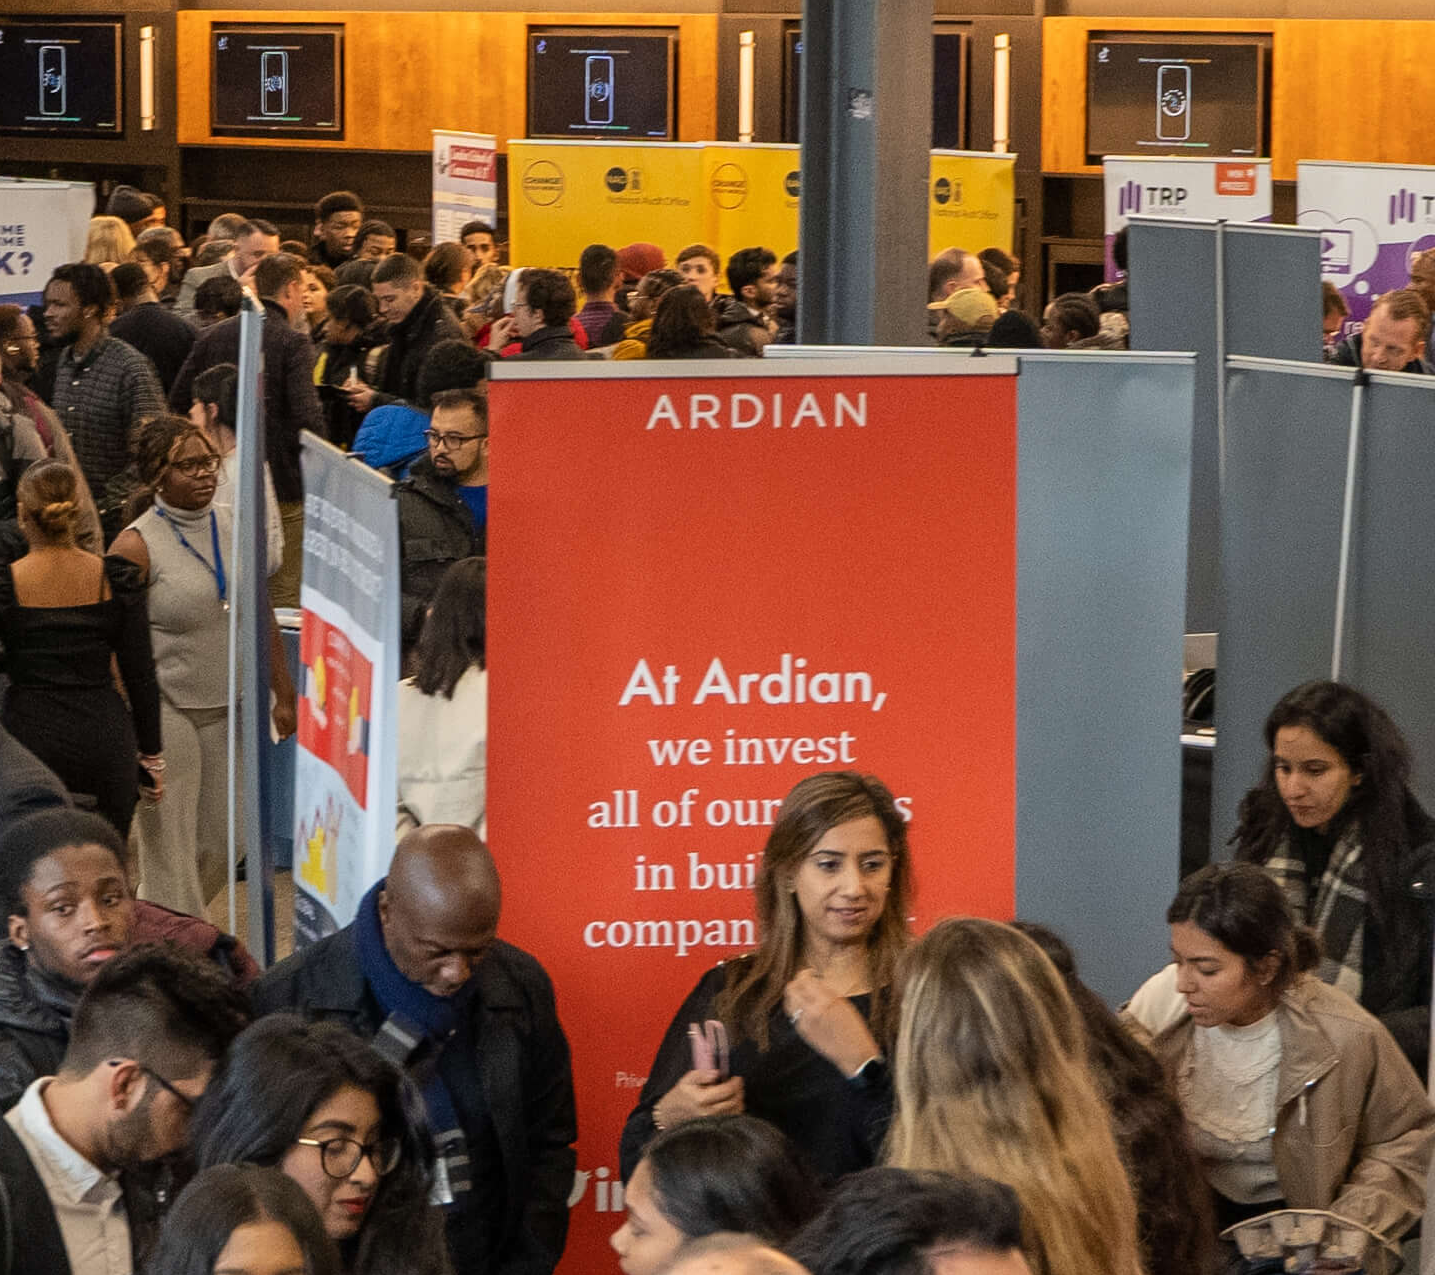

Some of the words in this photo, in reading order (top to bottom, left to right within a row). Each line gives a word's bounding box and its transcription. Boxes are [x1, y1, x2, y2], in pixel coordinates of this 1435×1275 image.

[1146, 186, 1187, 206] TRP
[646, 392, 867, 430] ARDIAN
[618, 658, 680, 706] At
[692, 653, 888, 712] Ardian,
[647, 735, 712, 766] we
[723, 728, 857, 766] invest
[587, 789, 641, 829] all
[651, 788, 700, 827] of
[634, 855, 676, 892] in
[583, 917, 756, 957] compan
